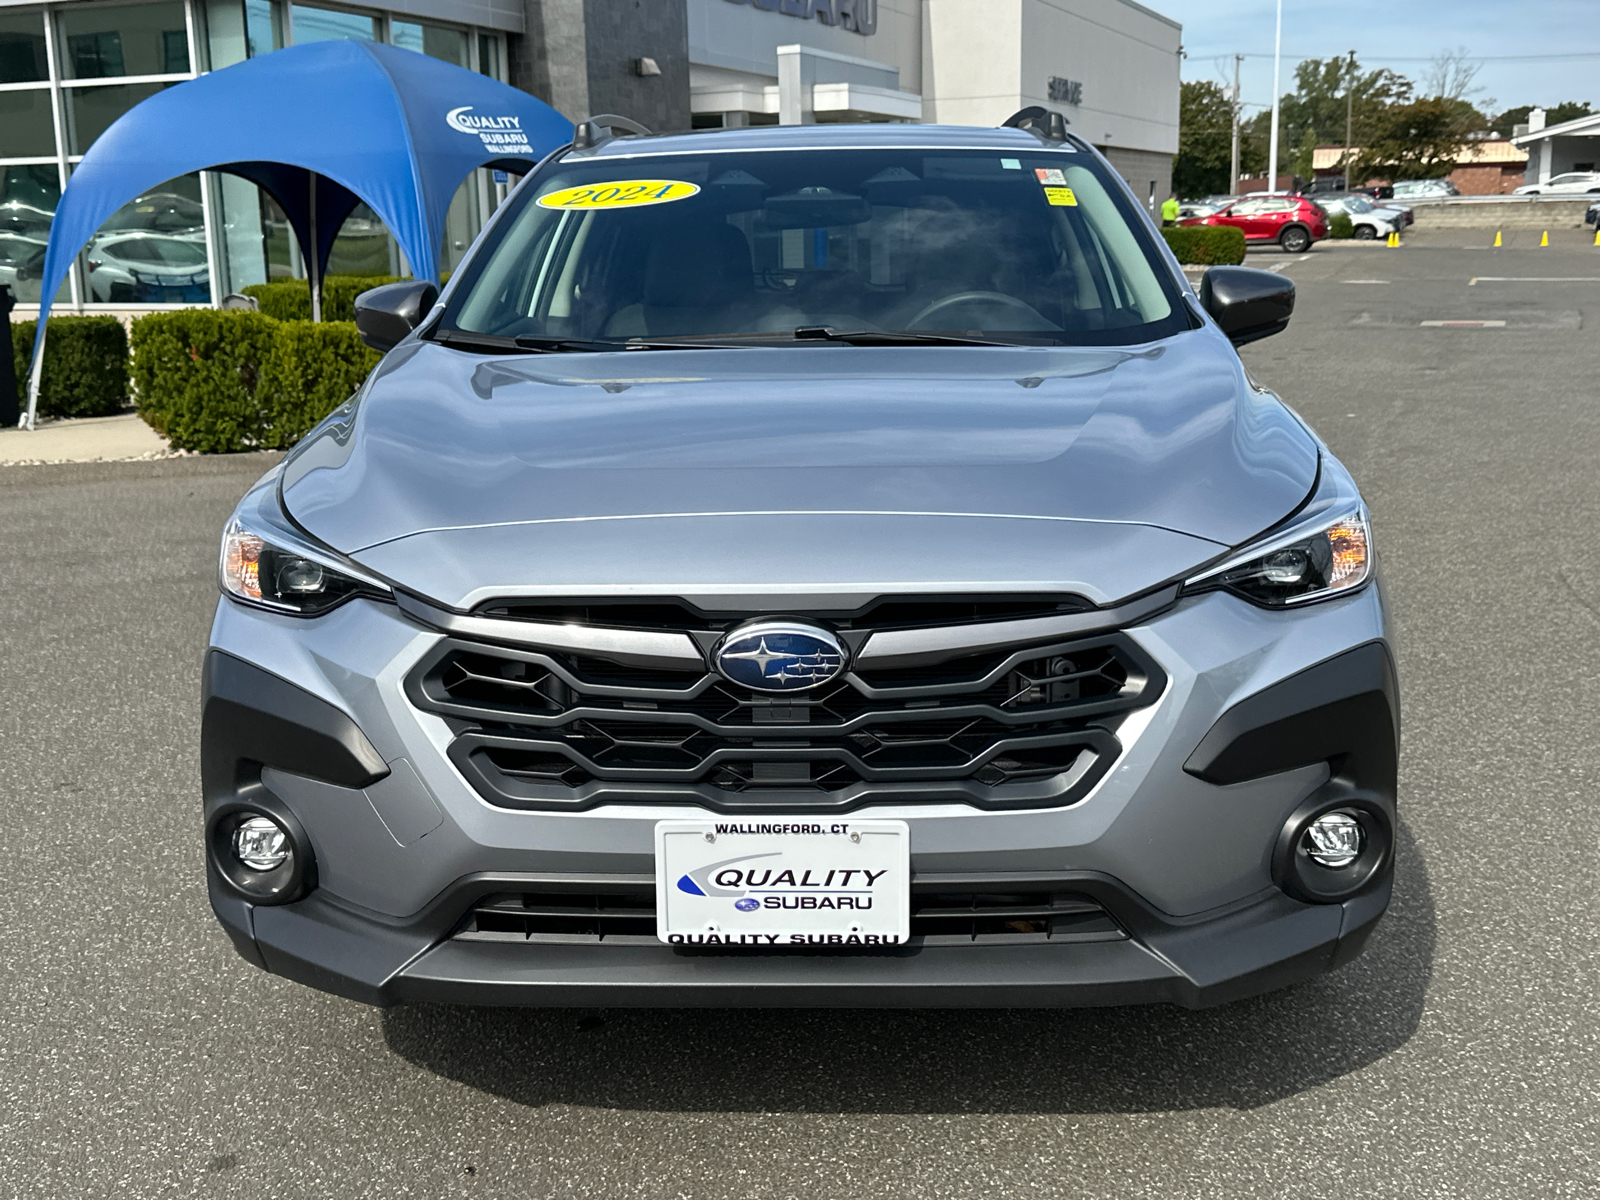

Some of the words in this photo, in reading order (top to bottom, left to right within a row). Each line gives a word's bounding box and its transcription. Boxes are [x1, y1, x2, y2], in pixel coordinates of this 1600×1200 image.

[457, 114, 520, 129] QUALITY
[479, 133, 528, 144] SUBARU
[562, 184, 674, 206] 2024
[831, 824, 849, 834] CT
[715, 869, 888, 887] QUALITY
[764, 897, 873, 910] SUBARU
[667, 933, 780, 945] QUALITY
[790, 933, 899, 945] SUBARU
